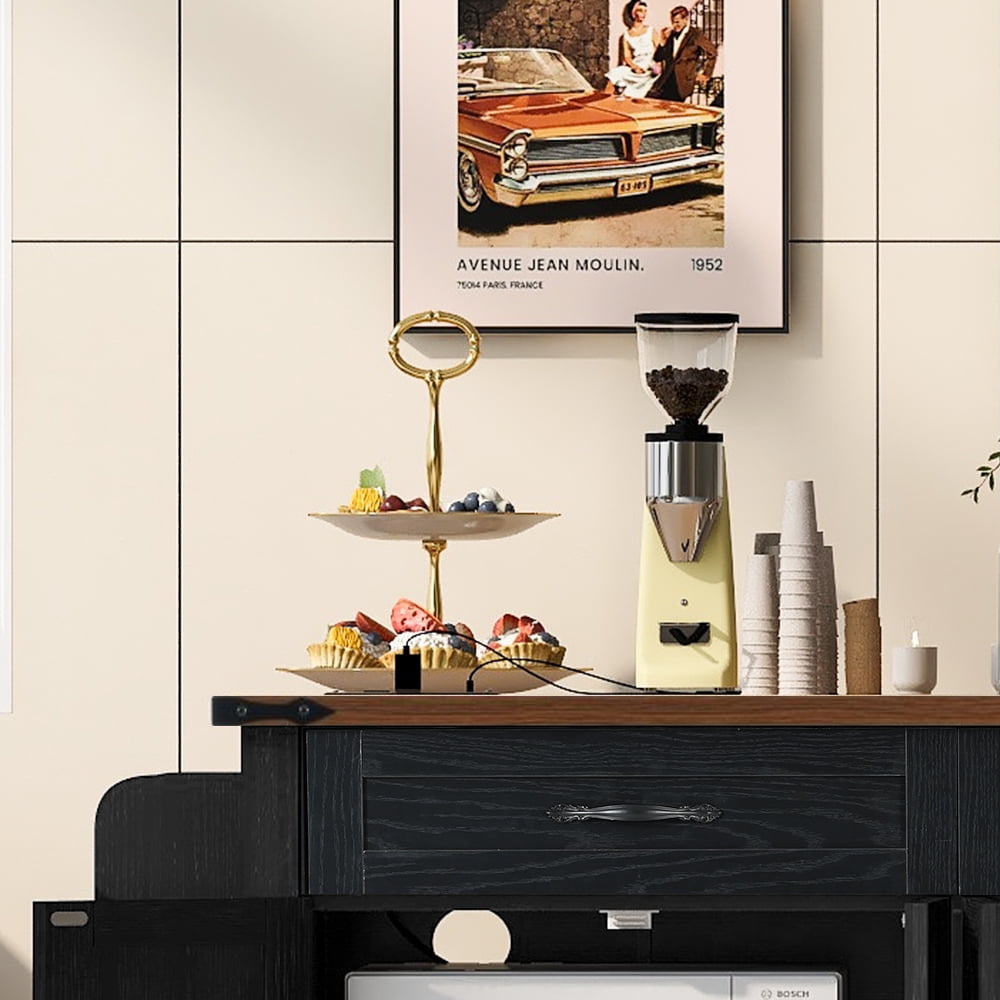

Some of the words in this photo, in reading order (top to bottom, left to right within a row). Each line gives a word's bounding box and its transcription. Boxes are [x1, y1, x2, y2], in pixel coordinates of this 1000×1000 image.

[457, 259, 522, 271] AVENUE
[528, 259, 569, 271] JEAN
[576, 259, 644, 271] MOULIN.
[691, 258, 723, 271] 1952
[510, 281, 543, 289] FRANCE
[777, 990, 809, 998] BOSCH
